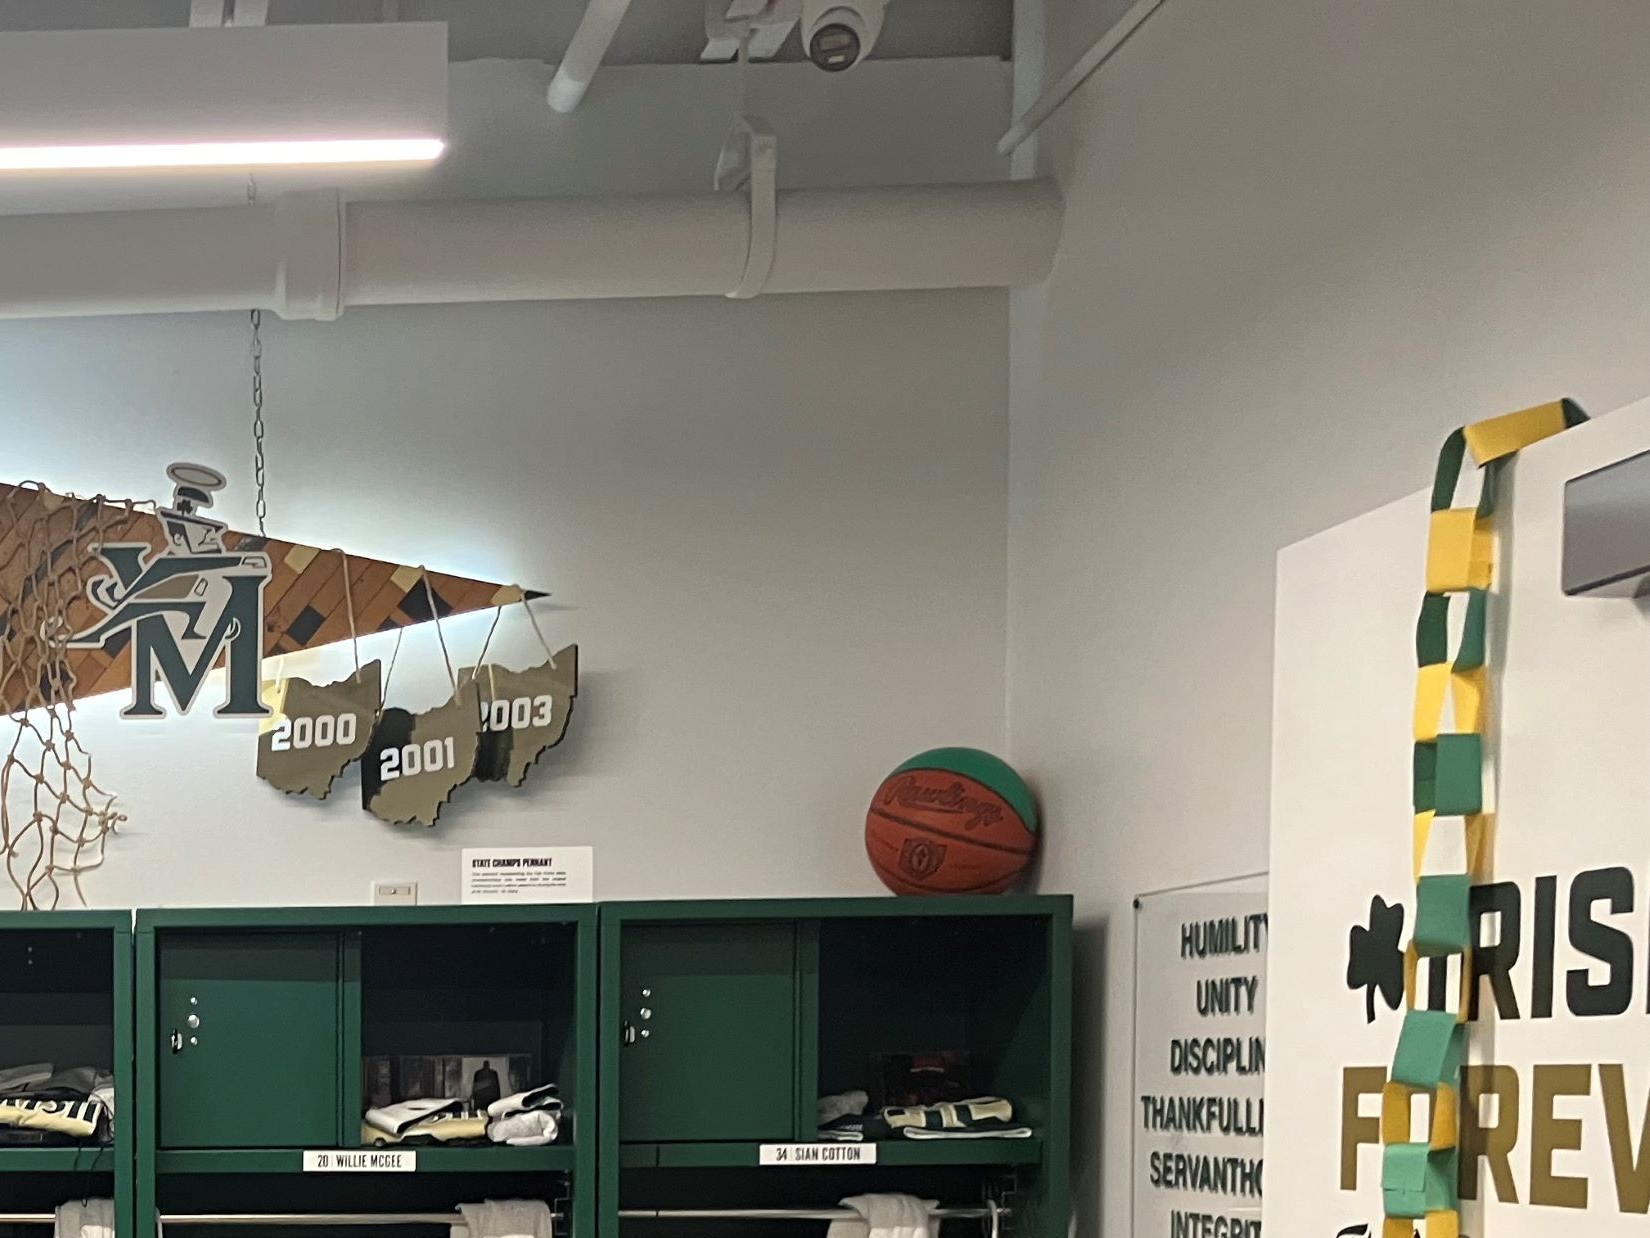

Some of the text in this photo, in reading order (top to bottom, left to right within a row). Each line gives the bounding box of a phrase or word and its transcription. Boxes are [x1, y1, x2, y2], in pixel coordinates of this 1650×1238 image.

[271, 713, 357, 752] 2000
[379, 735, 455, 781] 2001
[1427, 866, 1650, 1021] RIS
[1196, 974, 1259, 1017] UNITY
[1140, 1094, 1265, 1138] THANKFULL
[794, 1147, 819, 1161] SIAN
[821, 1146, 861, 1161] COTTON
[1340, 1063, 1650, 1214] FREV
[317, 1154, 402, 1168] 20 WILLIE MCGEE
